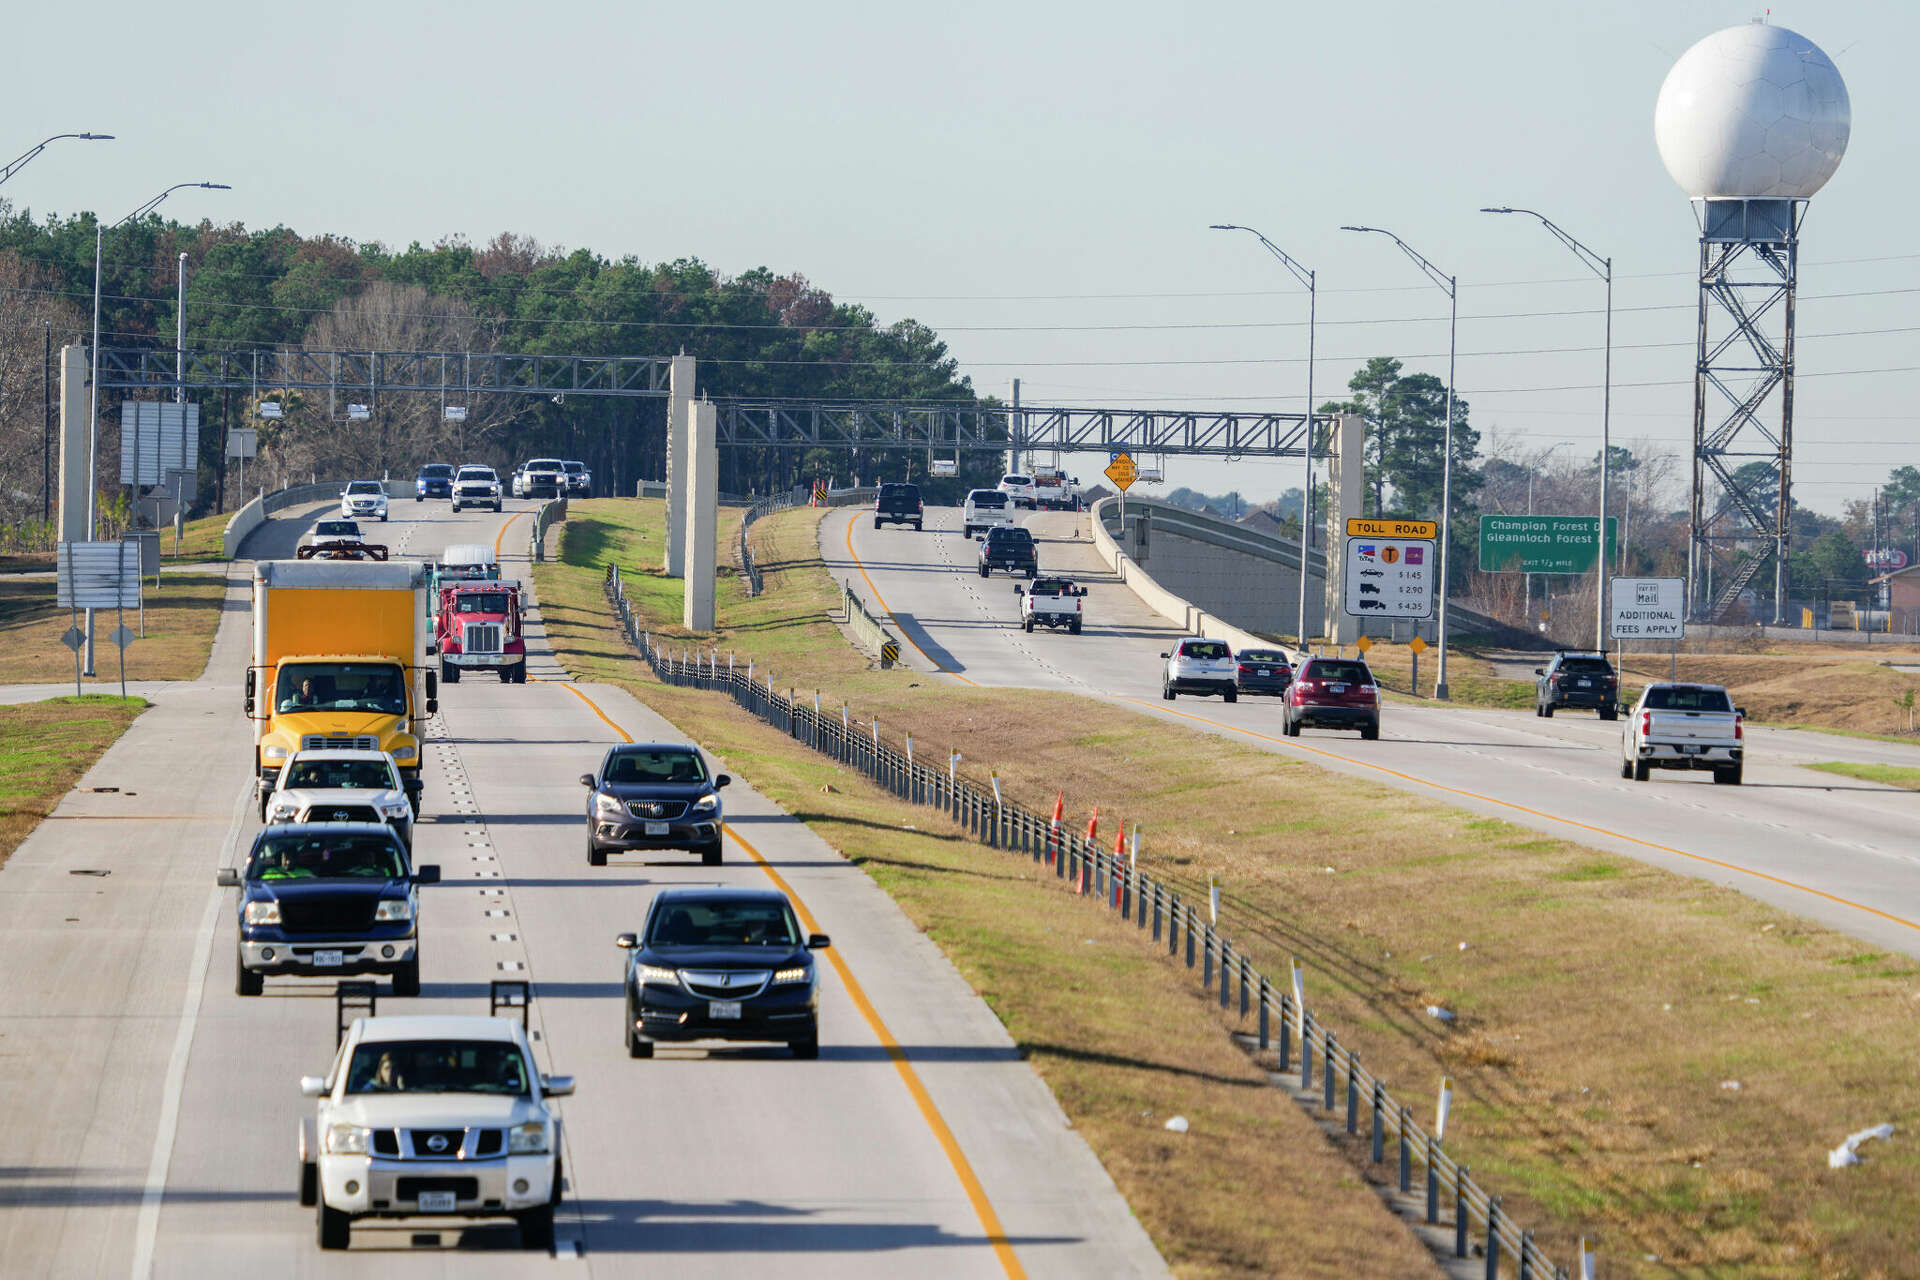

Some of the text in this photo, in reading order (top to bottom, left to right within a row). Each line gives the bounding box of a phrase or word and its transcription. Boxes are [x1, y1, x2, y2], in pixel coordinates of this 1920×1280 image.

[1356, 524, 1427, 534] TOLL ROAD
[1491, 520, 1547, 533] Champion
[1553, 522, 1588, 531] Forest
[1487, 533, 1550, 543] Gleannloch
[1556, 534, 1592, 543] Forest
[1638, 594, 1656, 602] Mail
[1620, 610, 1676, 620] ADDITIONAL
[1616, 625, 1678, 633] FEES APPLY
